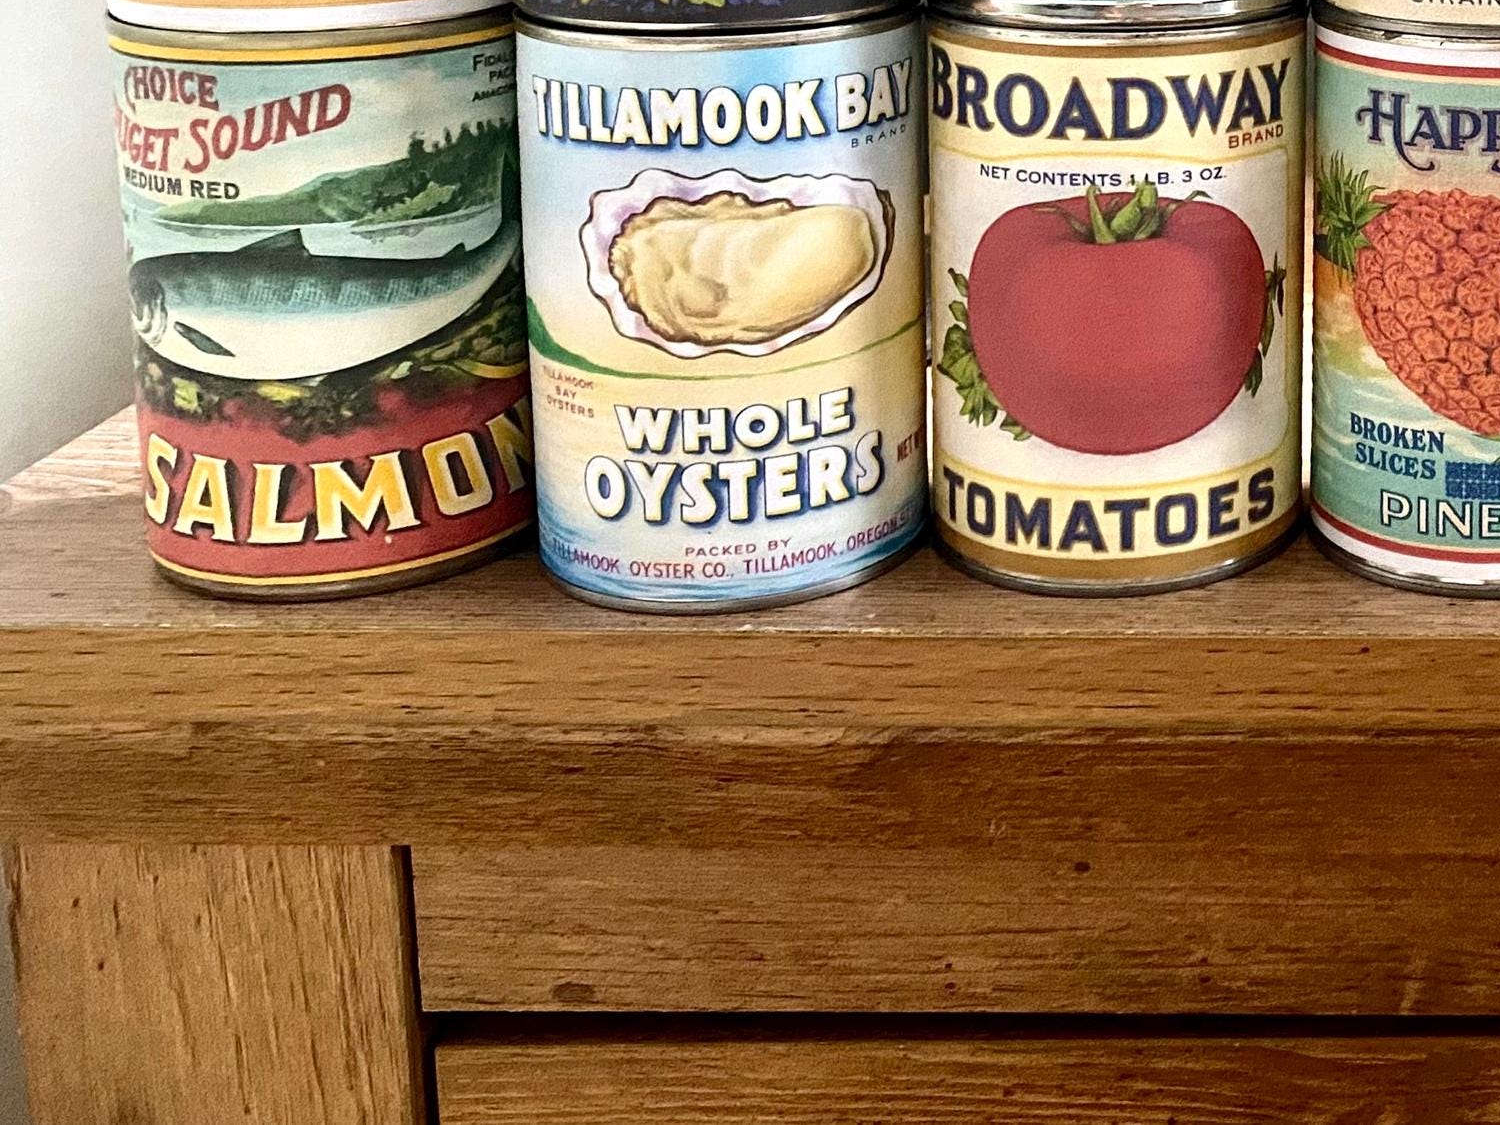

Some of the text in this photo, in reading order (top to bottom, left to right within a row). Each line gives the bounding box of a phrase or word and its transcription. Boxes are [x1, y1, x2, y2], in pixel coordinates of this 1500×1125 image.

[124, 65, 219, 113] CHOICE
[532, 57, 913, 148] TILLAMOOK BAY
[931, 43, 1291, 142] BROADWAY
[184, 83, 352, 174] SOUND
[851, 123, 907, 148] BRAND
[1228, 124, 1284, 149] BRAND
[124, 165, 240, 200] MEDIUM RED
[979, 163, 1010, 180] NET
[1015, 168, 1122, 188] CONTENTS
[1143, 171, 1174, 186] LB.
[1182, 169, 1193, 184] 3
[1199, 165, 1227, 181] OZ.
[547, 394, 594, 418] OYSTERS
[614, 386, 855, 455] WHOLE
[1350, 412, 1445, 454] BROKEN
[145, 395, 533, 544] SALMON
[585, 429, 884, 526] OYSTERS
[1355, 442, 1437, 480] SLICES
[943, 466, 1275, 553] TOMATOES
[552, 538, 620, 575] TILLAMOOK
[629, 559, 695, 579] OYSTER
[685, 537, 793, 557] PACKED BY
